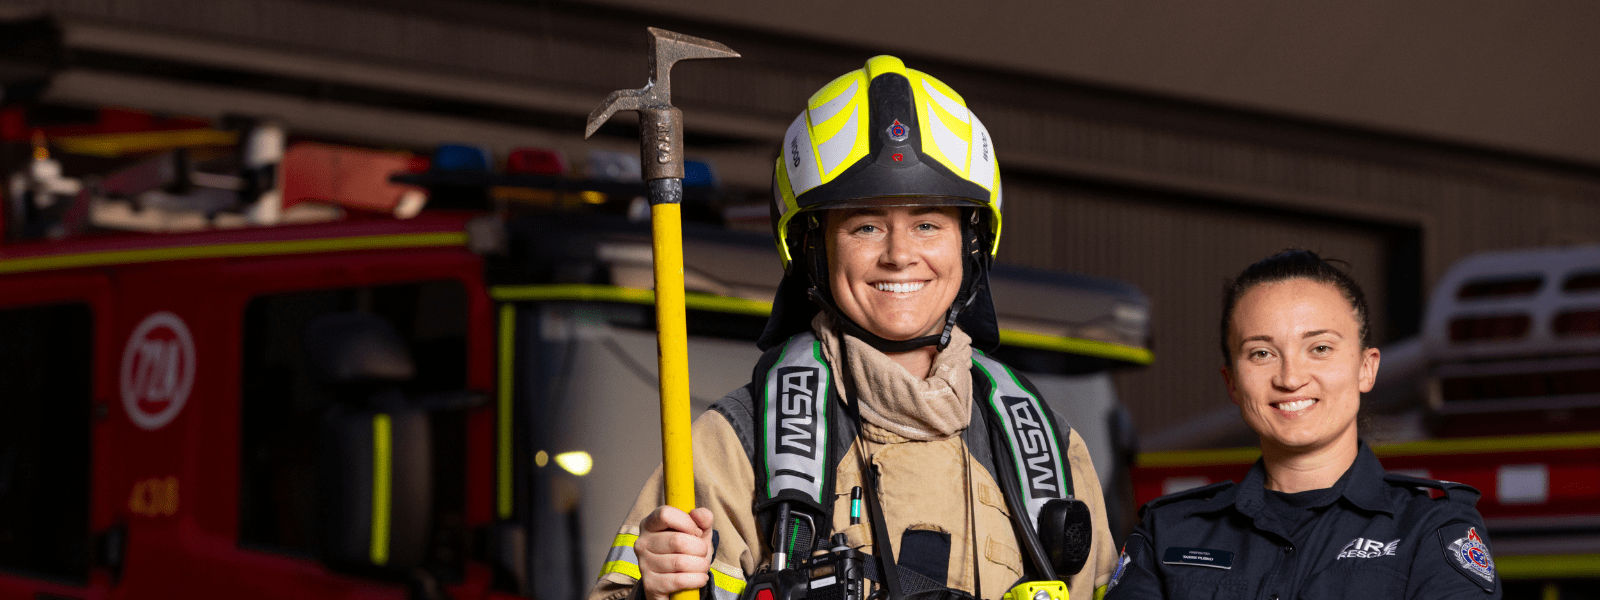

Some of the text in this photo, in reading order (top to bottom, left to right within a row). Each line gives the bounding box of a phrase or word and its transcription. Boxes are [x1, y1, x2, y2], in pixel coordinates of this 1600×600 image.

[791, 136, 800, 167] WOOD
[782, 370, 814, 453] MSA
[1010, 401, 1056, 492] MSA
[1338, 537, 1400, 557] FIRE
[1338, 549, 1396, 559] RESCUE
